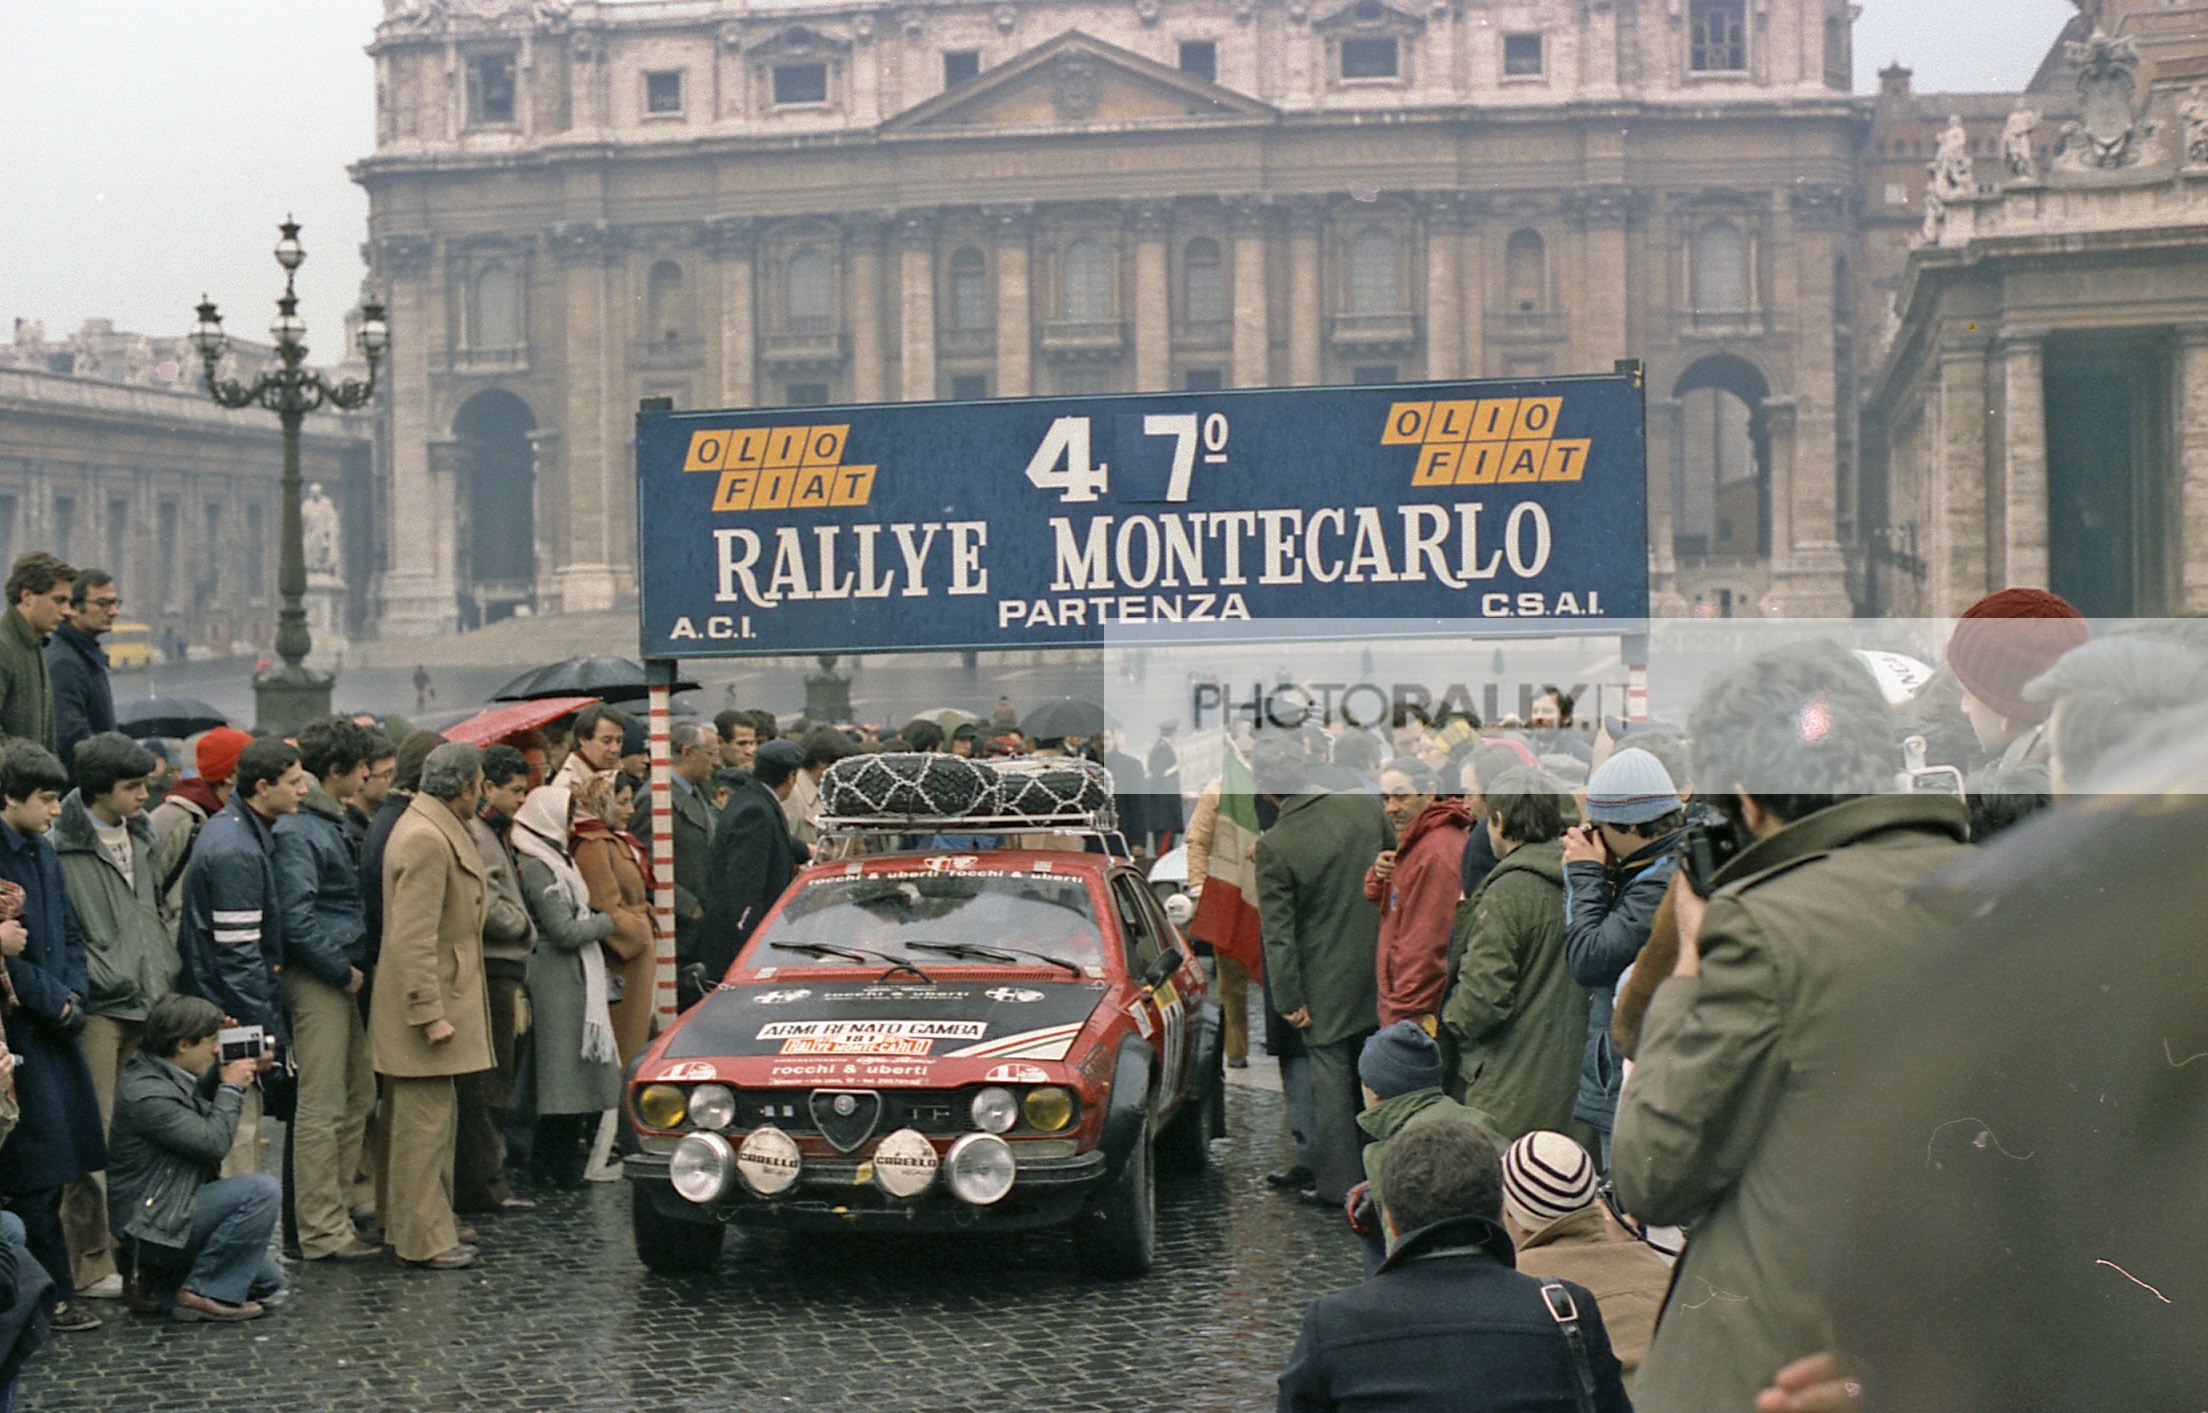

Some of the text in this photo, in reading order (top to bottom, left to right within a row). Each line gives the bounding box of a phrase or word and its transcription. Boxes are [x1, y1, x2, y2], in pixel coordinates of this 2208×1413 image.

[1395, 403, 1549, 436] OLIO
[698, 432, 836, 463] OLIO
[1426, 447, 1580, 477] FIAT
[725, 473, 867, 503] FIAT
[712, 501, 1552, 608] RALLYE MONTECARLO
[998, 592, 1251, 628] PARTENZA
[1481, 592, 1604, 618] C.S.A.I.
[669, 616, 757, 639] A.C.I.
[808, 869, 1083, 886] rocchi & uberti rocchi & uberti
[763, 1024, 816, 1035] ARMI
[908, 1024, 979, 1036] GAMBA
[772, 1064, 928, 1075] rocchi & uberti
